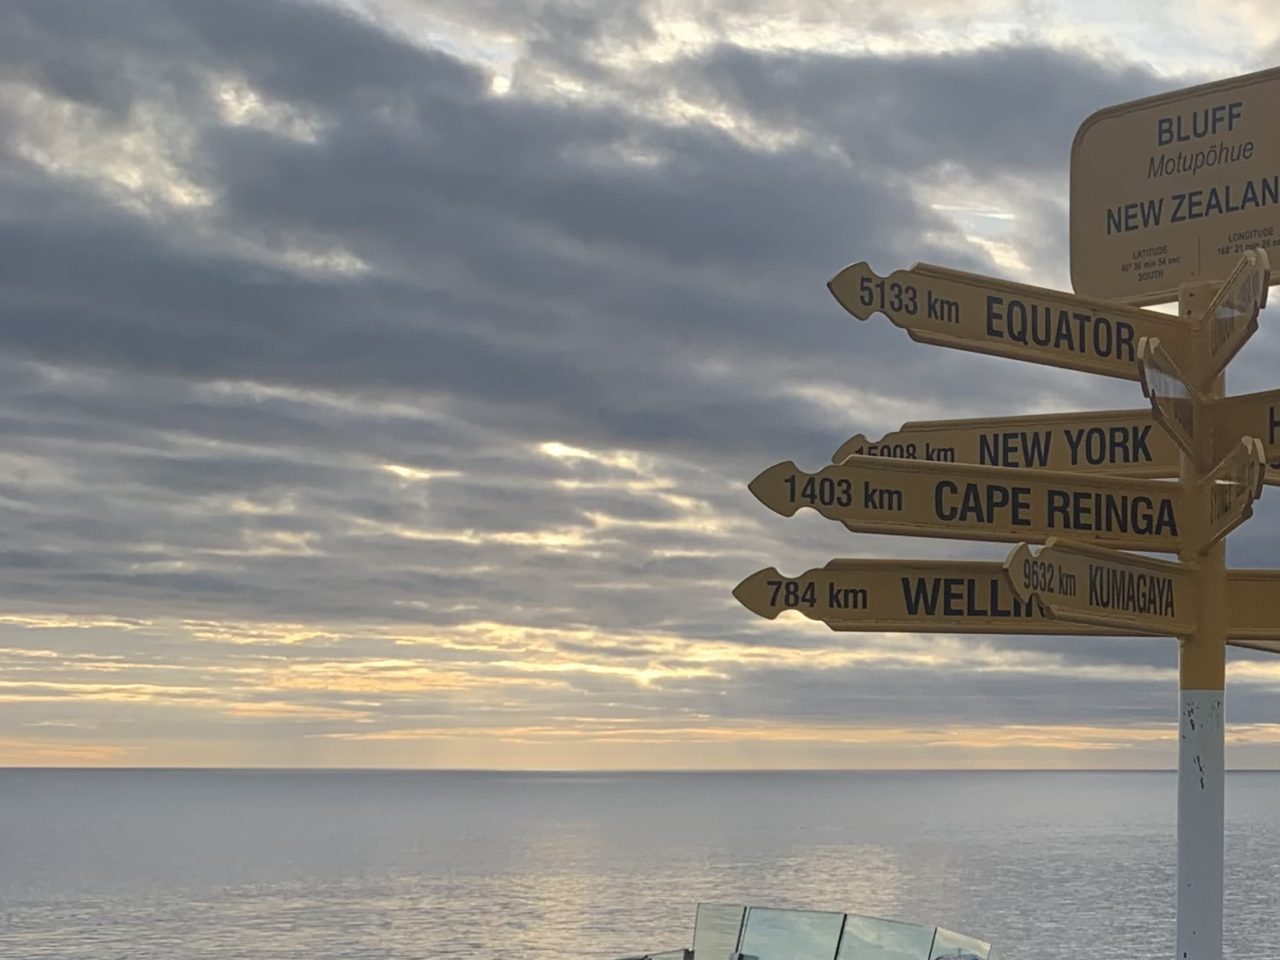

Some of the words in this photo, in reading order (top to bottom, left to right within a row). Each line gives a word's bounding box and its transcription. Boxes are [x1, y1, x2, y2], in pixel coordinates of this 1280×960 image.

[1157, 102, 1243, 147] BLUFF
[1147, 140, 1255, 179] Motupōhue
[1106, 198, 1164, 236] NEW
[1228, 226, 1274, 243] LONGITUDE
[1132, 245, 1169, 260] LATITUDE
[1168, 256, 1181, 265] sec
[1137, 268, 1164, 282] SOUTH
[859, 276, 919, 316] 5133
[927, 290, 960, 324] km
[986, 295, 1135, 362] EQUATOR
[926, 443, 955, 463] km
[979, 431, 1053, 468] NEW
[1064, 425, 1154, 465] YORK
[784, 475, 853, 508] 1403
[864, 482, 903, 512] km
[934, 480, 1032, 527] CAPE
[1047, 490, 1179, 538] REINGA
[766, 580, 818, 609] 784
[828, 582, 868, 609] km
[1023, 558, 1055, 594] 9632
[1058, 565, 1077, 598] km
[1088, 564, 1176, 618] KUMAGAYA
